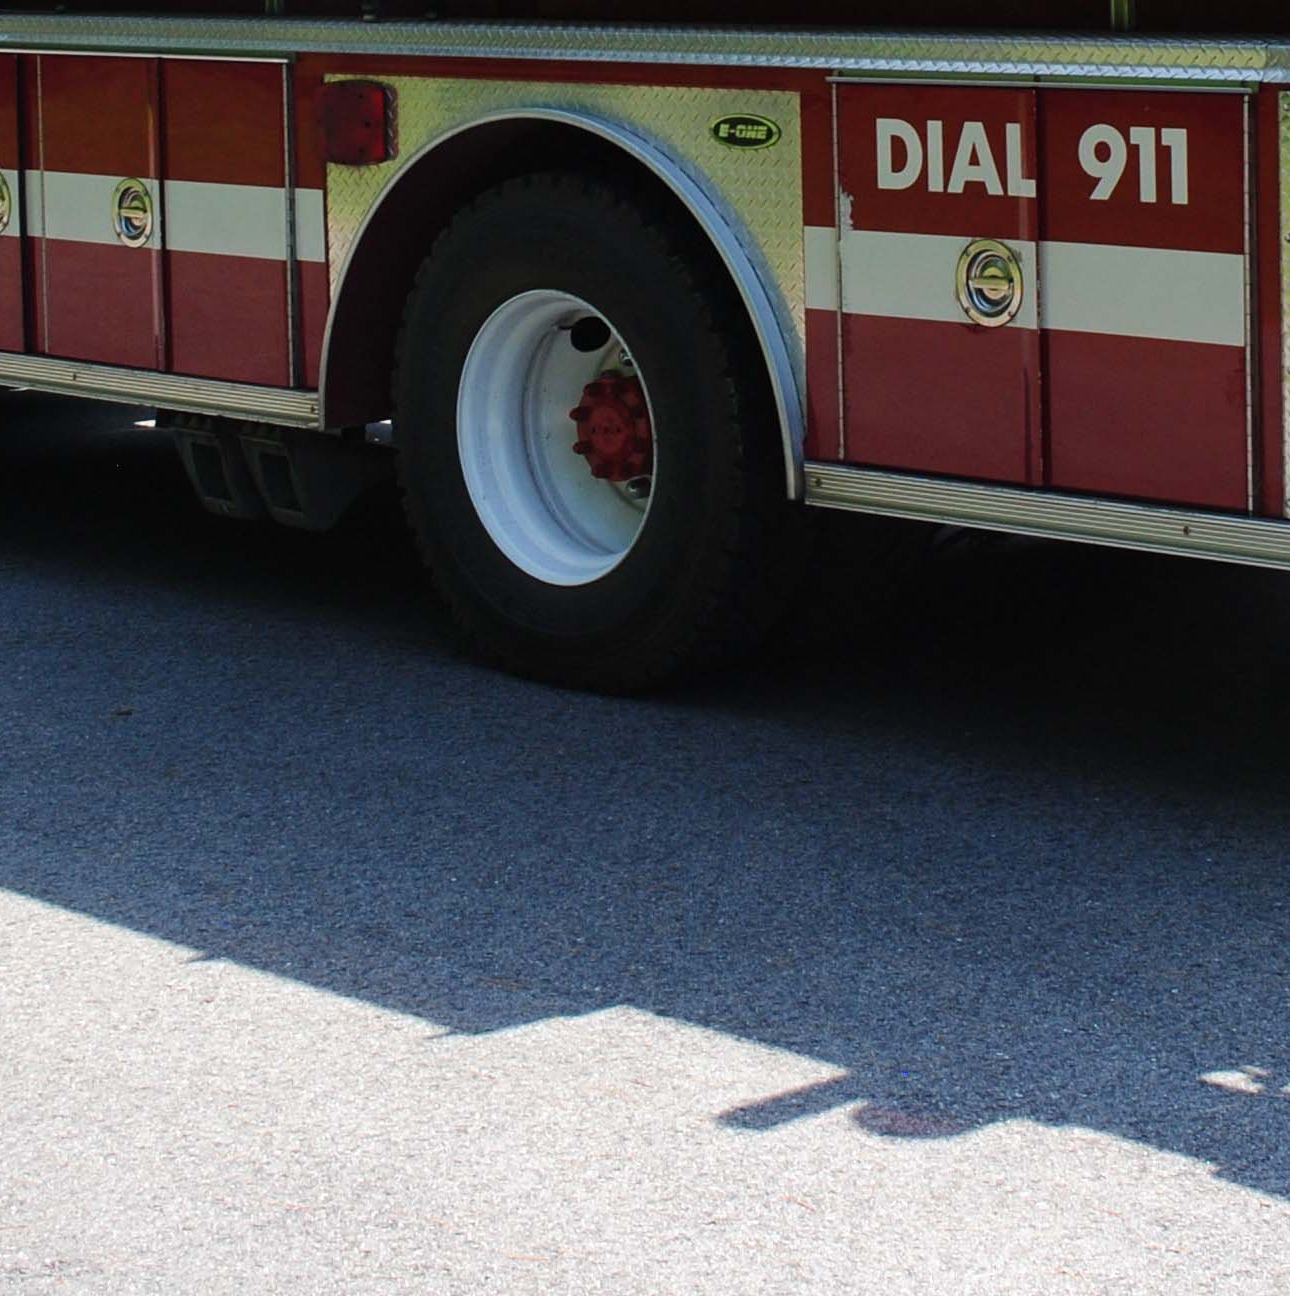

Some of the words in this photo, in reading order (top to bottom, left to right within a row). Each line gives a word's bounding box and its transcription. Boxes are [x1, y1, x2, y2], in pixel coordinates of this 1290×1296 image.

[718, 123, 768, 140] E-ONE
[875, 117, 1037, 199] DIAL
[1077, 122, 1189, 204] 911
